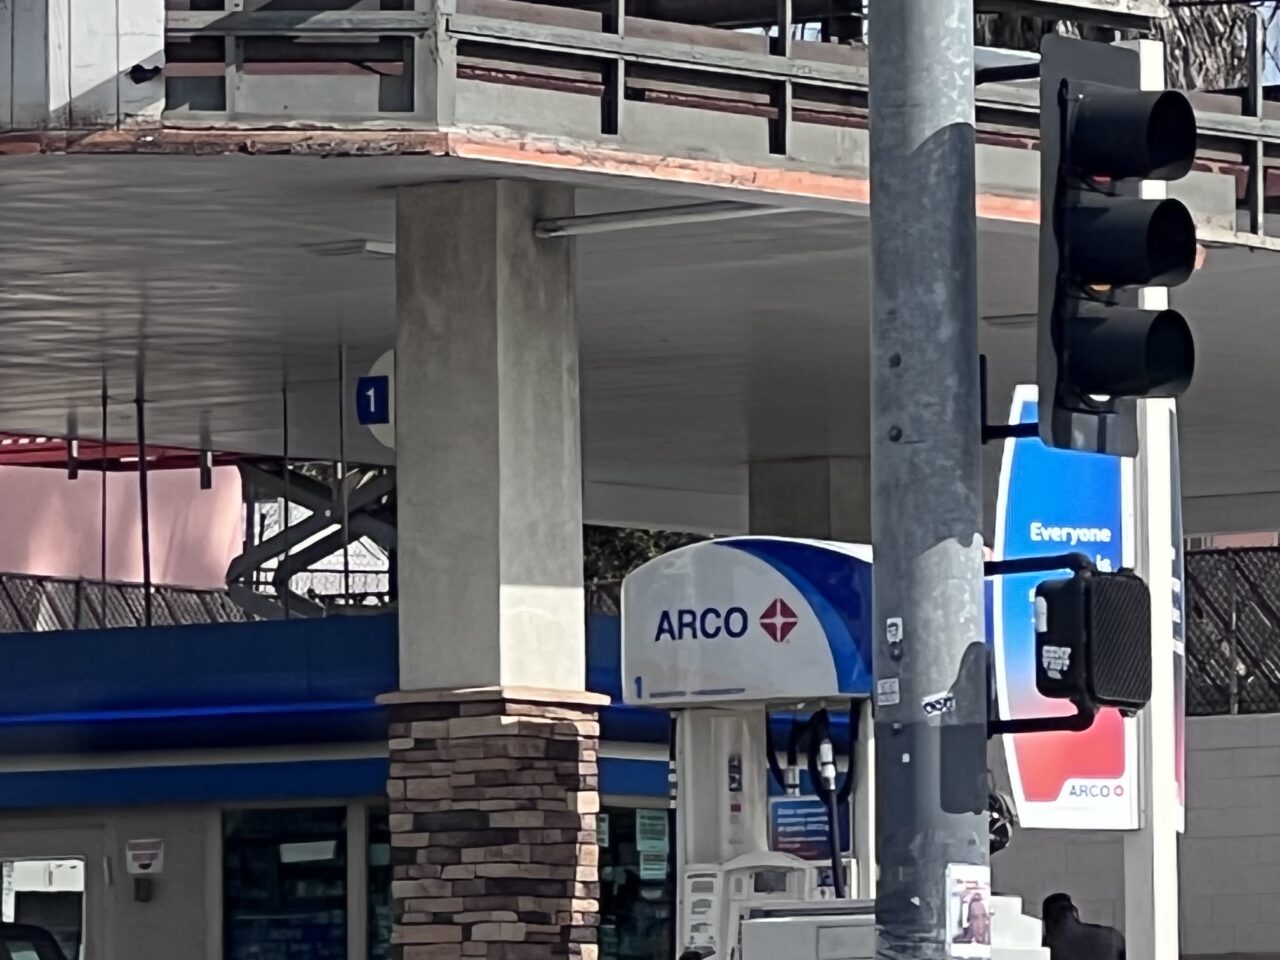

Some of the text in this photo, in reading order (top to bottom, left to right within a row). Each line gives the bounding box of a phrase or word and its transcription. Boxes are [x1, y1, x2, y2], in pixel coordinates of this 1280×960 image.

[365, 388, 375, 412] 1
[1029, 521, 1112, 546] Everyone
[654, 606, 749, 642] ARCO
[633, 676, 643, 700] 1
[1068, 784, 1111, 798] ARCO
